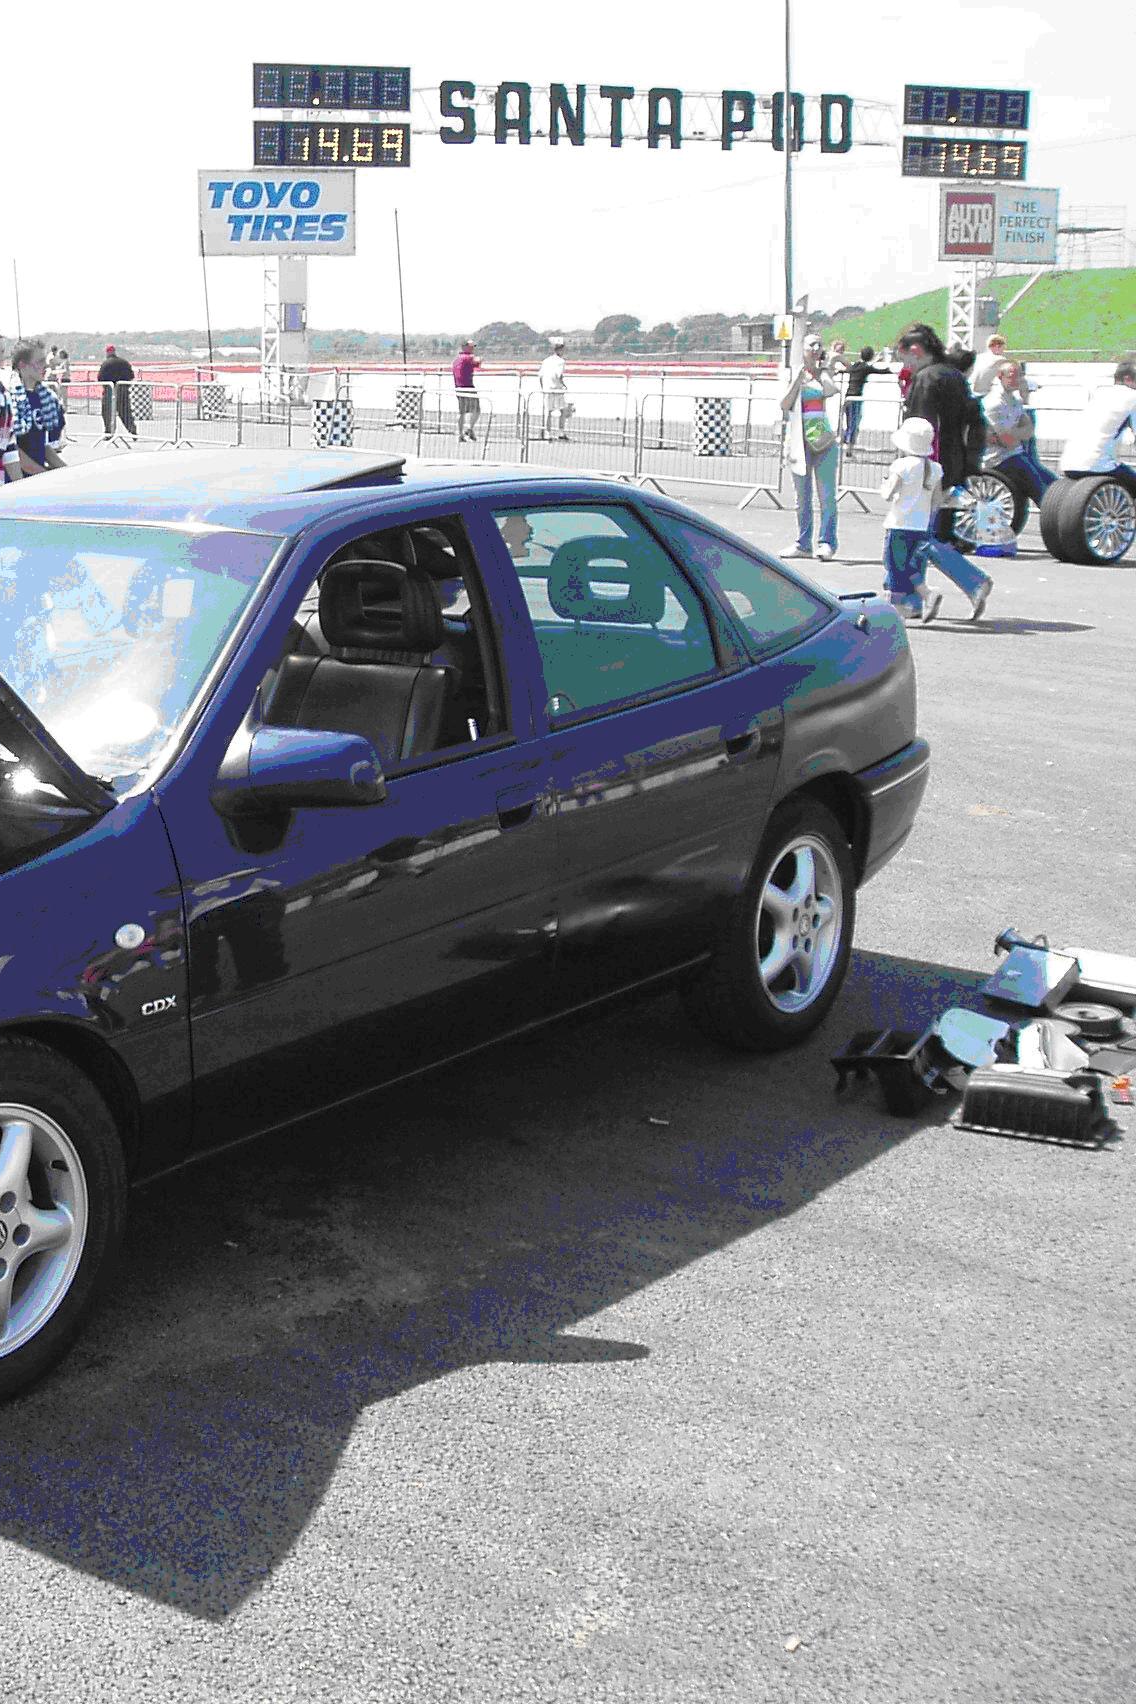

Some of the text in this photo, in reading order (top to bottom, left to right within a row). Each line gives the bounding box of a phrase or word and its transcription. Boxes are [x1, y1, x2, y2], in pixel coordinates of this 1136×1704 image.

[440, 80, 853, 153] SANTA POD
[302, 128, 403, 161] 14.69
[208, 181, 320, 209] TOYO
[949, 202, 993, 224] AUTO
[1014, 201, 1038, 213] THE
[227, 213, 348, 242] TIRES
[947, 222, 993, 244] GLYM
[1000, 216, 1052, 229] PERFECT
[1005, 231, 1045, 244] FINISH
[141, 995, 176, 1015] CDX
